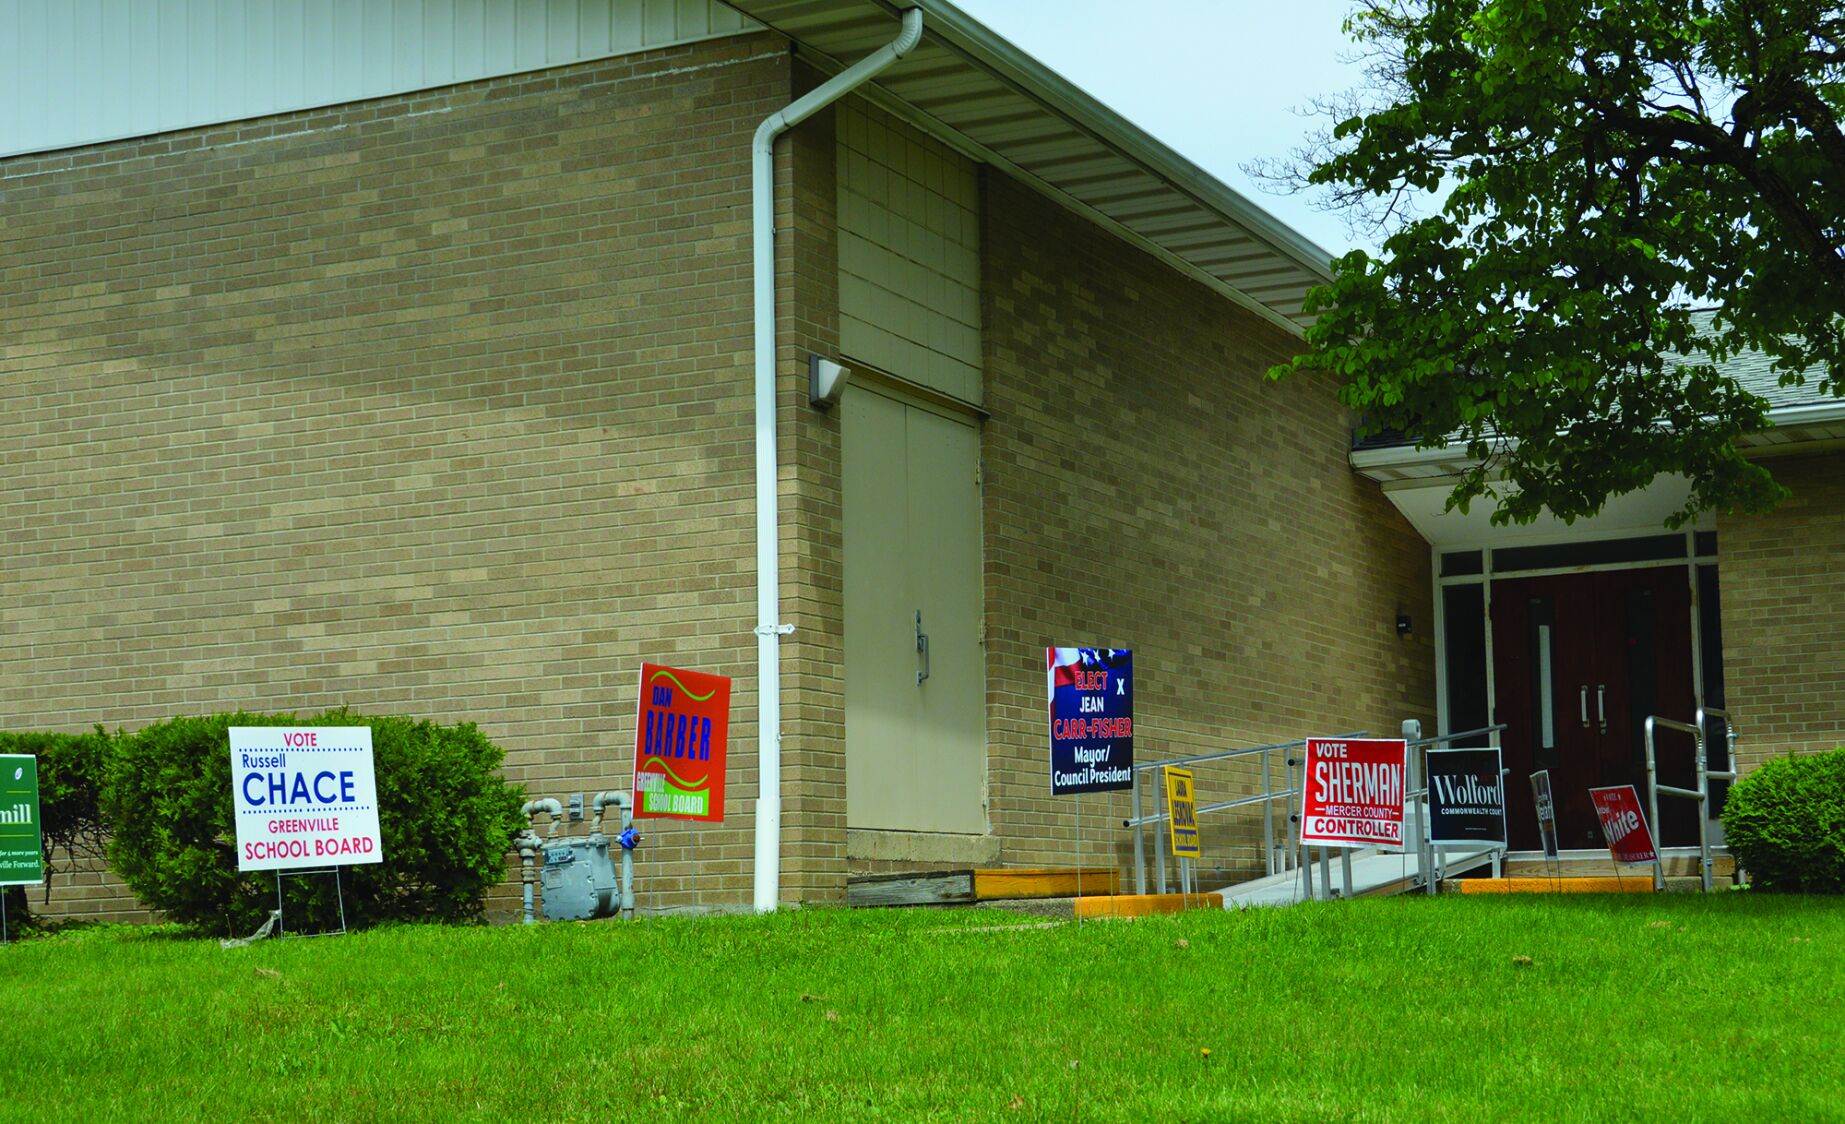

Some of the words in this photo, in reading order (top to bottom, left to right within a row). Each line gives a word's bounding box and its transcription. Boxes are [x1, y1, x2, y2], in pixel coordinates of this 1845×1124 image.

[1075, 671, 1108, 690] ELECT
[1116, 678, 1125, 695] X
[652, 686, 672, 707] DAN
[1080, 697, 1104, 713] JEAN
[644, 710, 711, 761] BARBER
[1054, 717, 1132, 740] CARR-FISHER
[284, 733, 317, 747] VOTE
[1316, 743, 1347, 758] VOTE
[242, 753, 286, 768] Russell
[1074, 745, 1110, 767] Mayor/
[1055, 768, 1089, 786] Council
[1090, 766, 1131, 783] President
[1315, 761, 1400, 806] SHERMAN
[243, 771, 355, 806] CHACE
[1432, 774, 1501, 805] Wolford
[649, 793, 671, 812] SCHOOL
[673, 796, 703, 814] BOARD
[1326, 805, 1362, 816] MERCER
[1364, 807, 1392, 818] COUNTY
[268, 818, 339, 834] GREENVILLE
[1315, 818, 1398, 838] CONTROLLER
[1602, 810, 1639, 845] White
[245, 840, 310, 860] SCHOOL
[315, 837, 373, 857] BOARD
